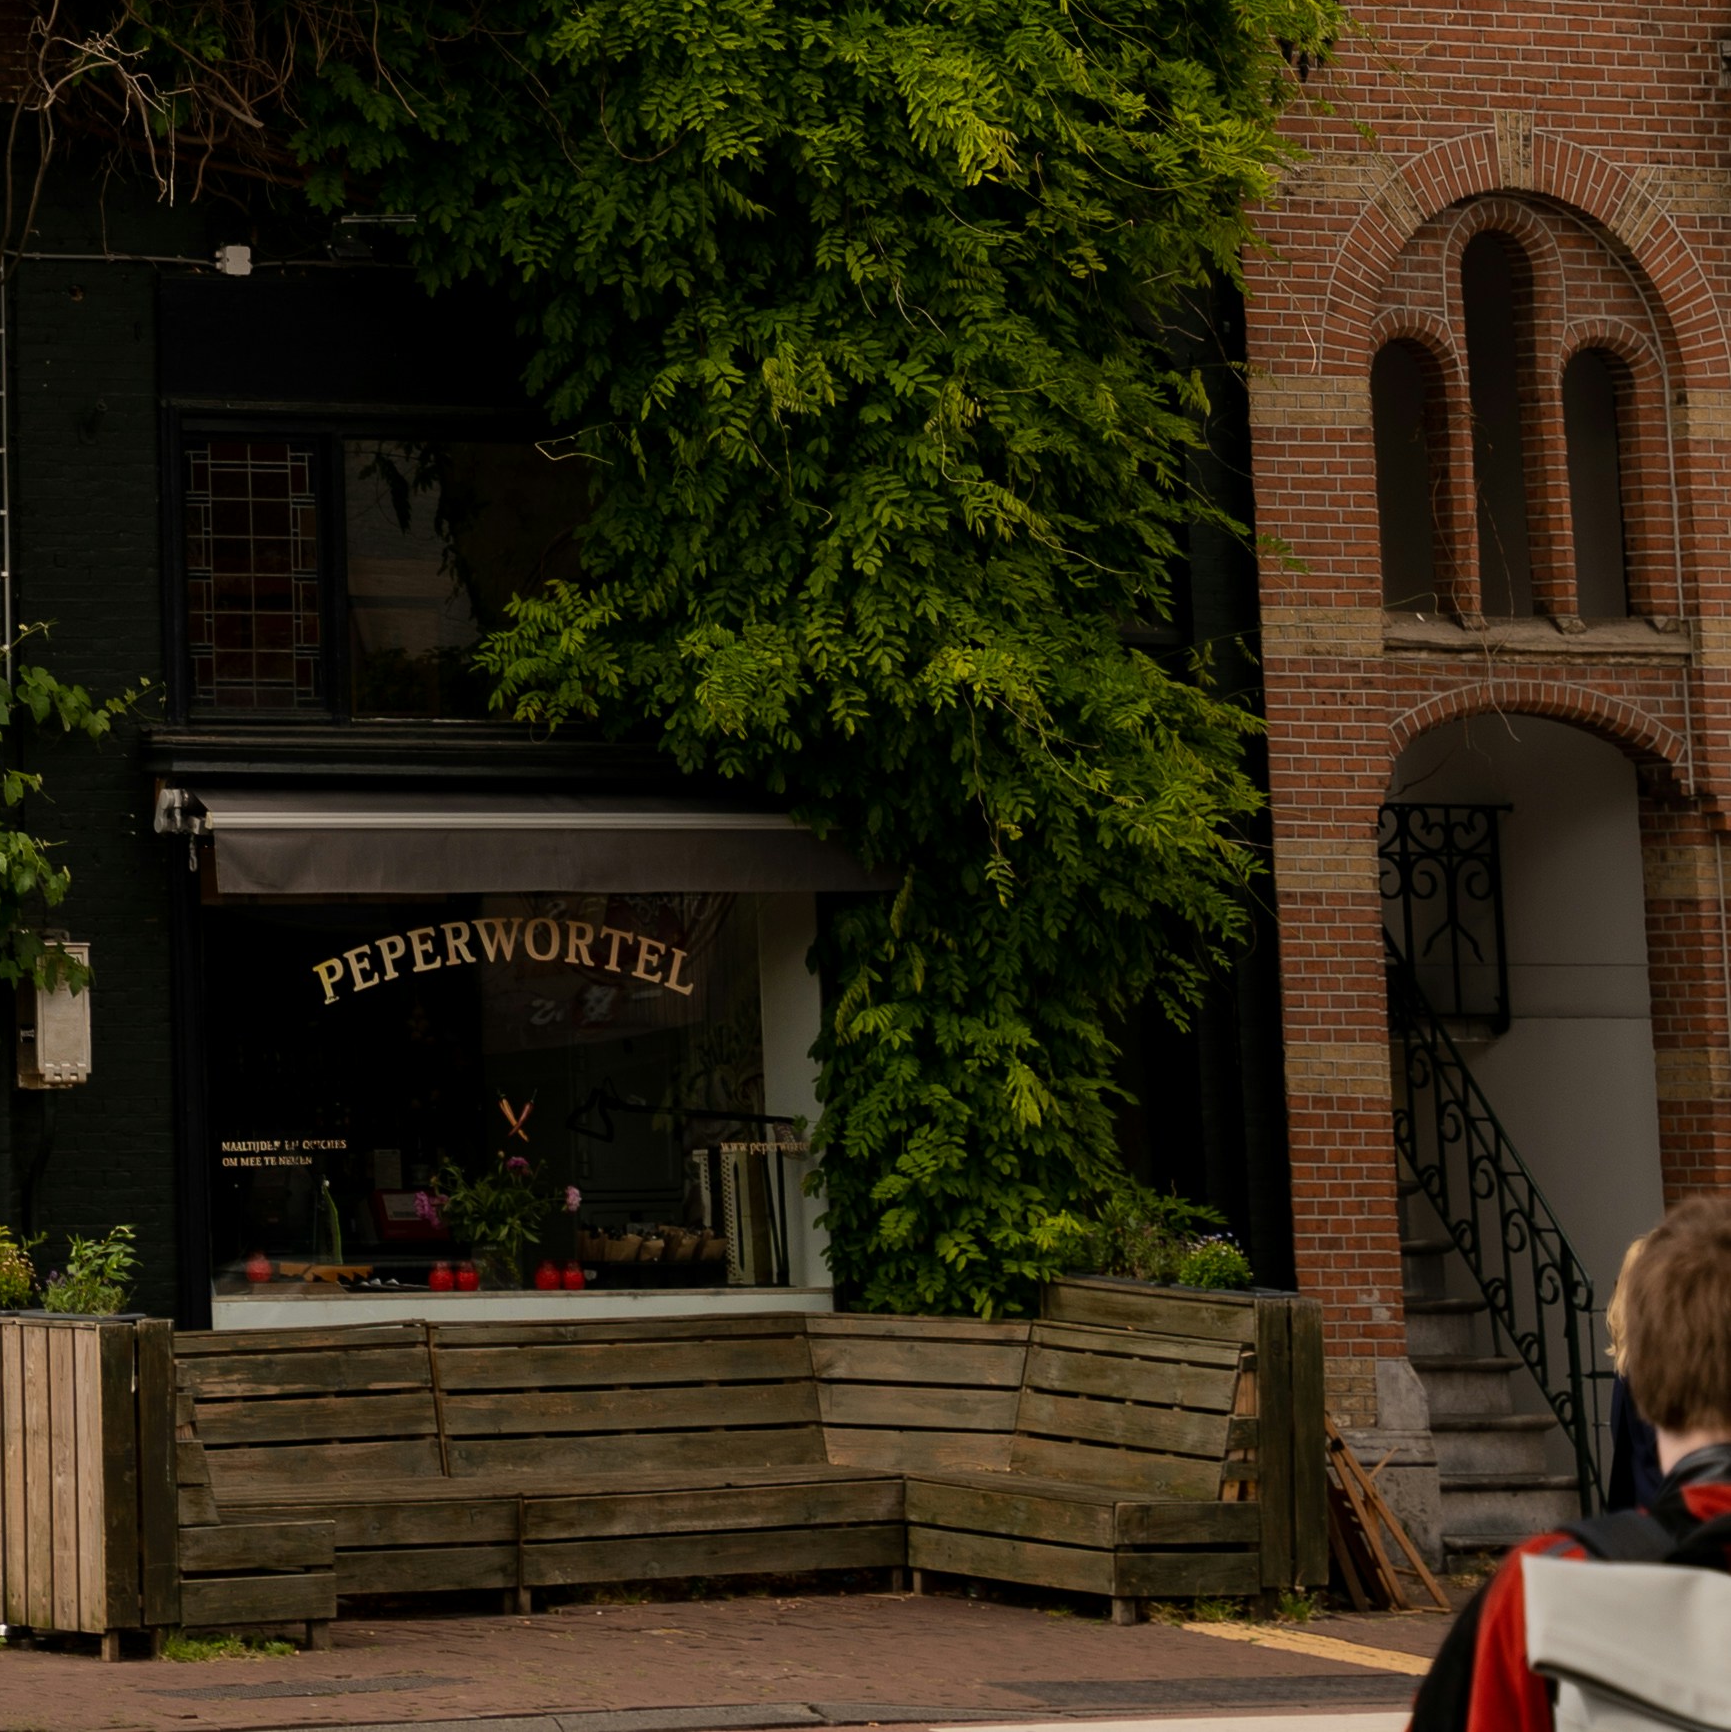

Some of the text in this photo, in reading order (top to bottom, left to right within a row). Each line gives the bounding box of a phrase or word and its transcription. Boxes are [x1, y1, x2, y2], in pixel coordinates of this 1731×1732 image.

[312, 916, 695, 1006] PEPERWORTEL
[222, 1157, 238, 1168] OM
[241, 1156, 262, 1167] MEE
[263, 1156, 278, 1166] TE
